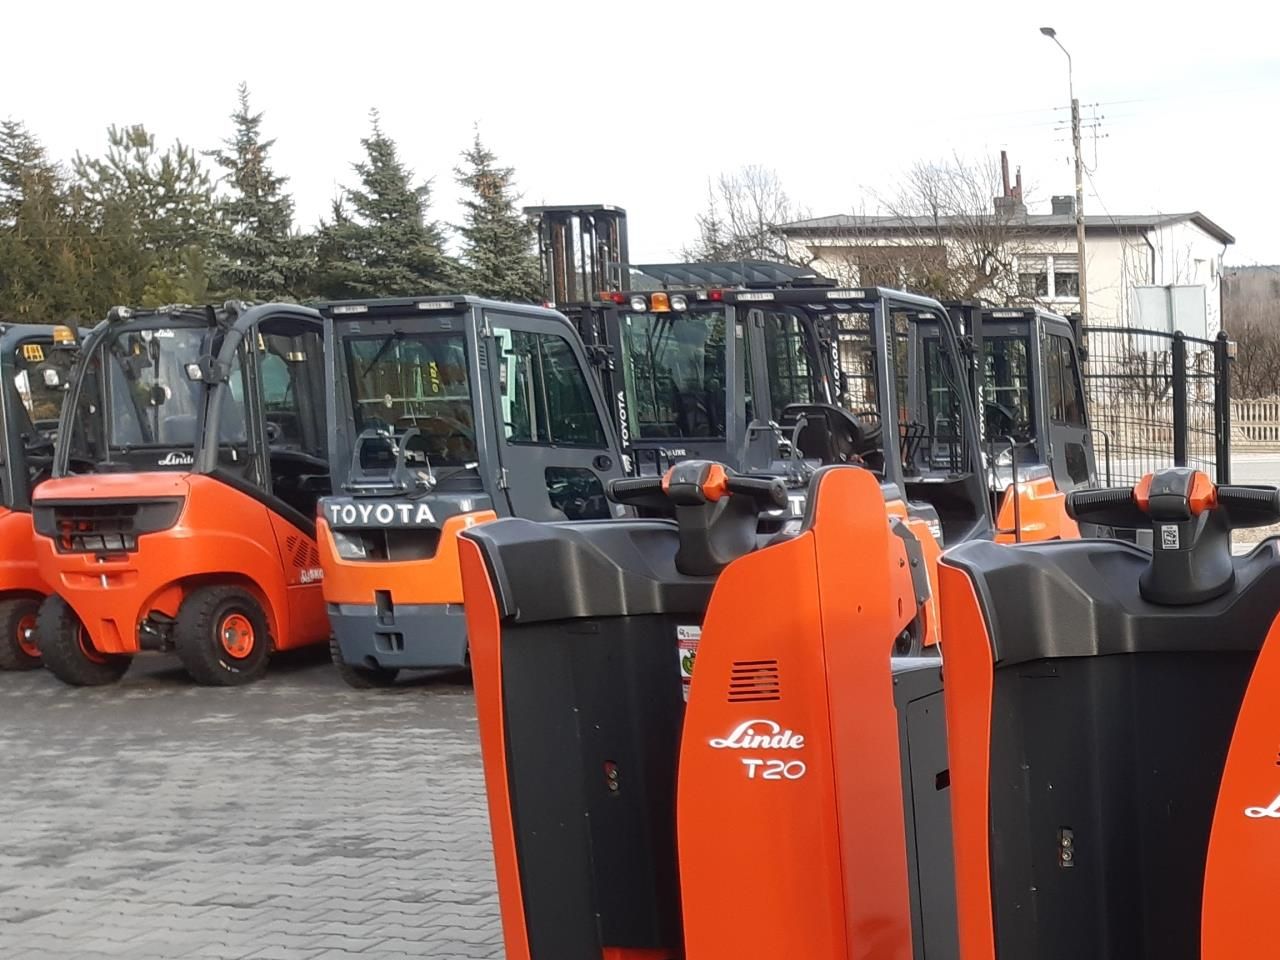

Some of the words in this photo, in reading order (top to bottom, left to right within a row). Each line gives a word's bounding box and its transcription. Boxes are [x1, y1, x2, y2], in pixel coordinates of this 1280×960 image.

[832, 340, 840, 397] TOYOTA
[617, 390, 630, 449] TOYOTA
[330, 503, 436, 524] TOYOTA
[709, 719, 805, 749] Linde
[741, 758, 806, 780] T20
